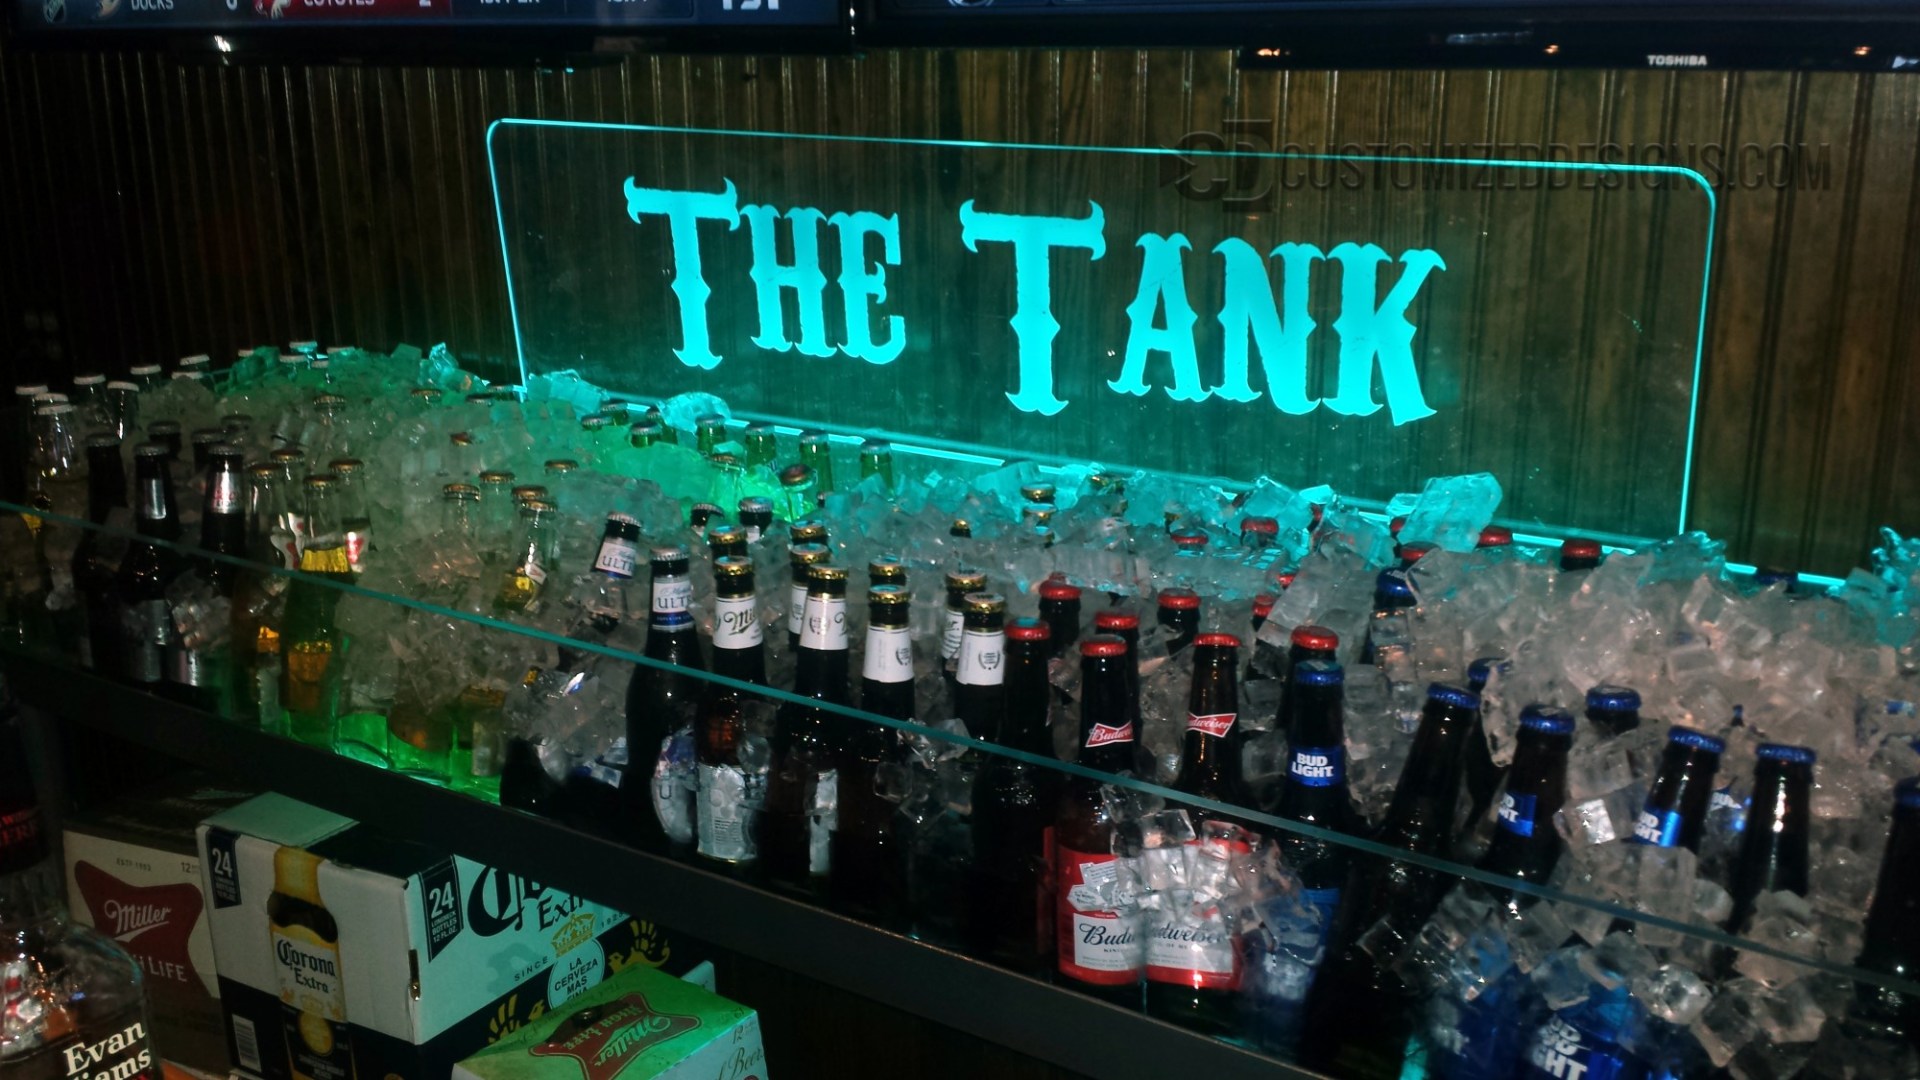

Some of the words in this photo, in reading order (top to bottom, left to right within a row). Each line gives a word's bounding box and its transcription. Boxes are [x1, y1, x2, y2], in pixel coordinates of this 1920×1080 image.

[1648, 55, 1708, 66] TOSHIBA
[624, 176, 907, 370] THE
[960, 200, 1446, 426] TANK
[1291, 761, 1334, 777] LIGHT
[1297, 752, 1328, 766] BUD
[180, 861, 191, 874] 12
[212, 847, 233, 878] 24
[429, 881, 454, 919] 24
[104, 899, 172, 936] Miller
[431, 918, 457, 936] BOTTLES
[148, 955, 188, 982] LIFE
[277, 939, 338, 980] Corona
[514, 956, 549, 982] SINCE
[569, 957, 582, 971] LA
[294, 966, 329, 993] Extra
[554, 958, 598, 991] CERVEZA
[566, 977, 588, 995] MAS
[63, 1022, 146, 1077] Evan
[594, 1015, 672, 1067] Miller
